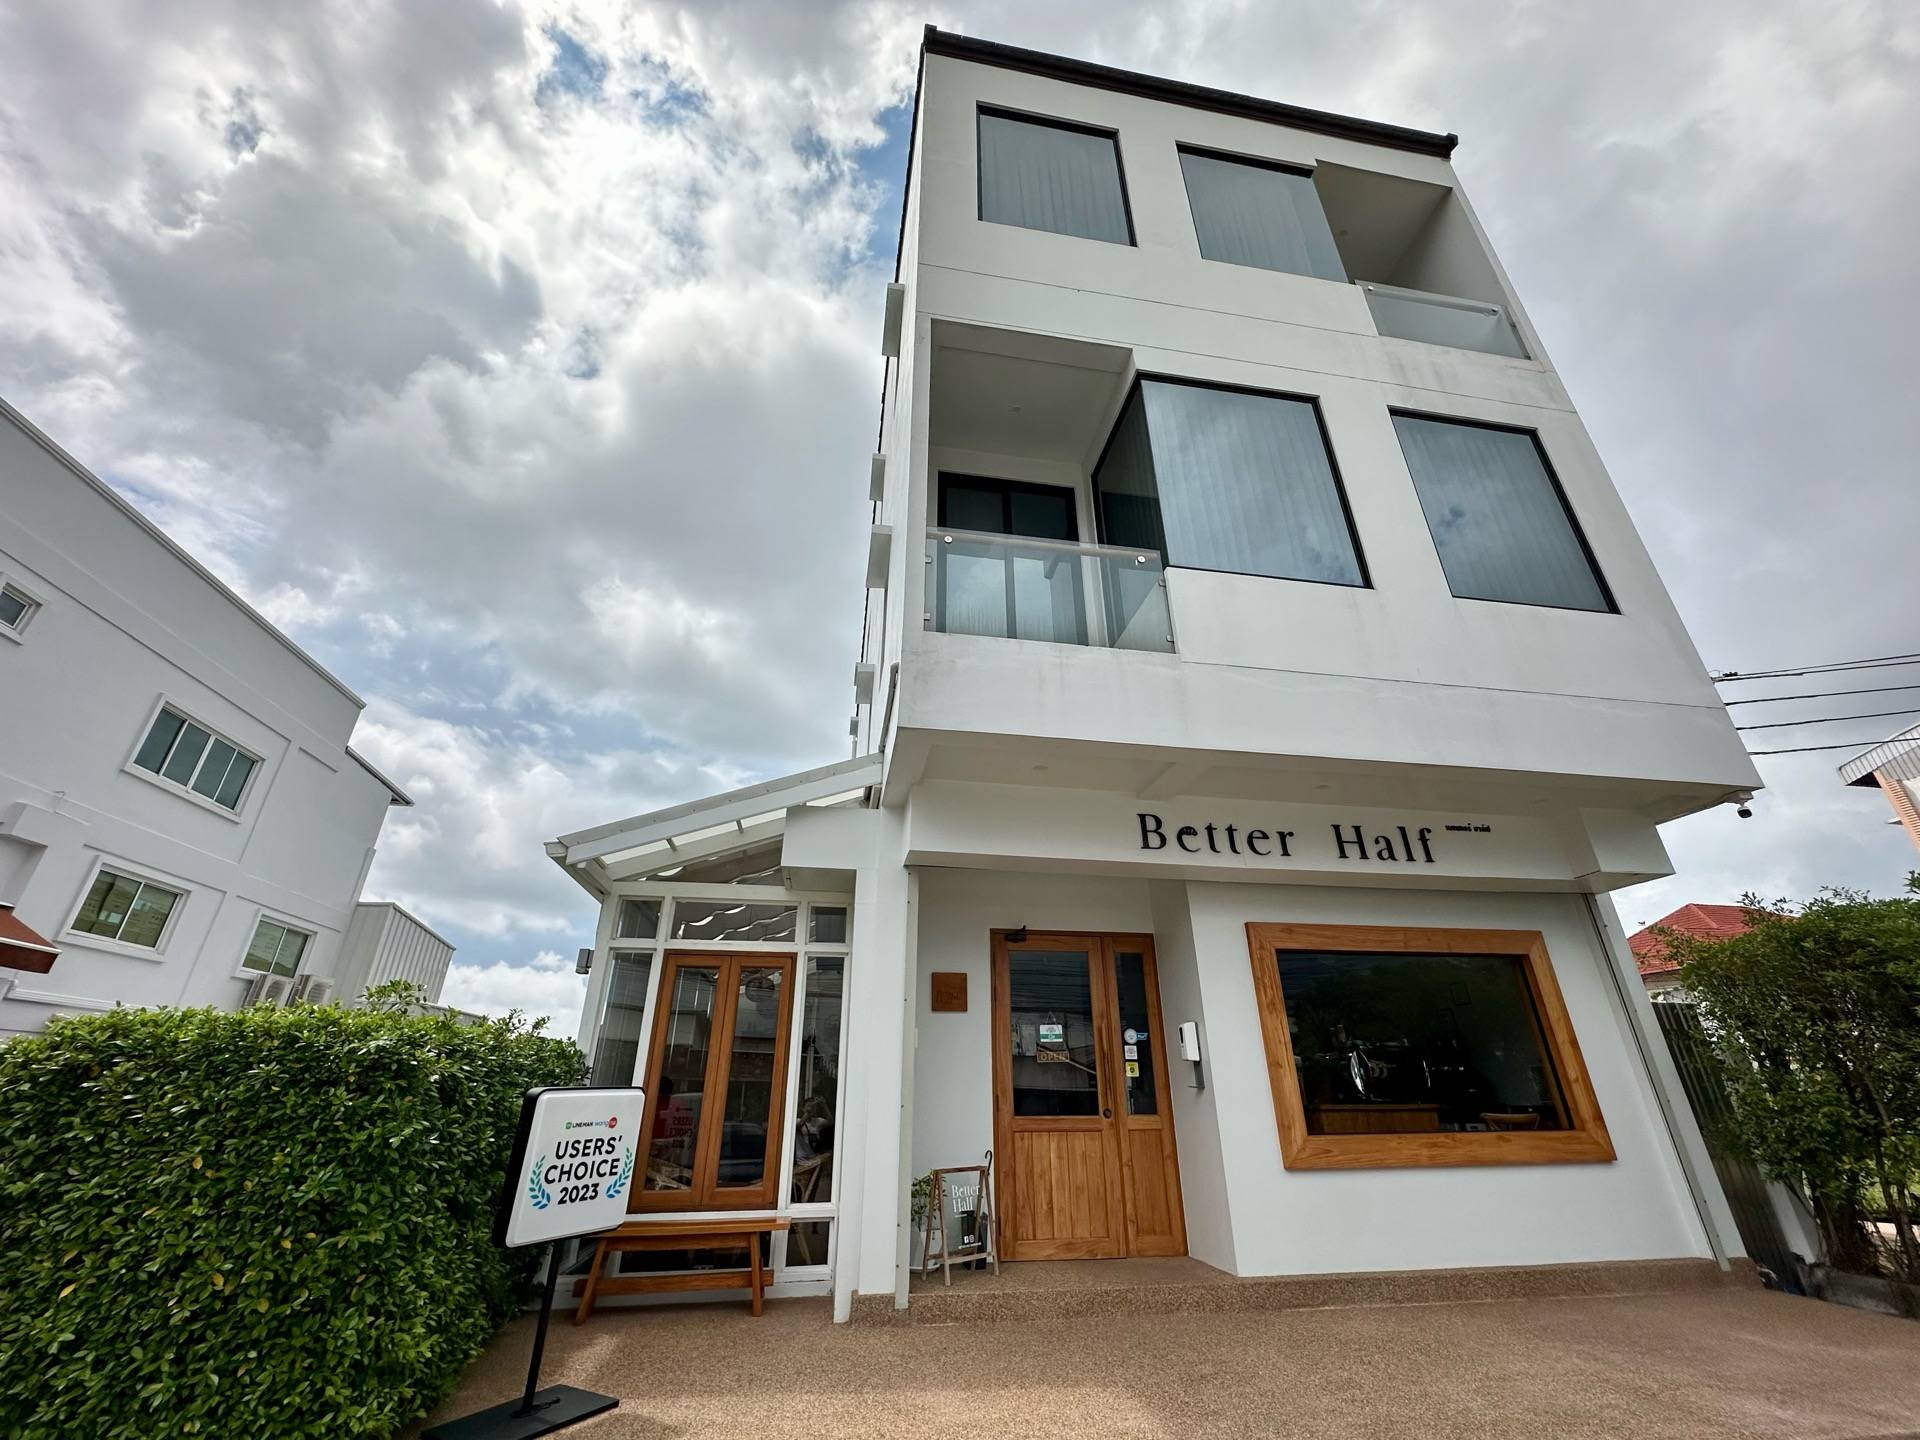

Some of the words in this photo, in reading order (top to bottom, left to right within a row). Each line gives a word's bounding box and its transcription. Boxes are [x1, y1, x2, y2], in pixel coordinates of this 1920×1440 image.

[1136, 813, 1295, 857] Better
[1330, 824, 1437, 863] Half
[555, 1135, 623, 1160] USERS'
[544, 1158, 620, 1184] CHOICE
[557, 1183, 600, 1205] 2023
[952, 1184, 980, 1198] Better
[953, 1197, 973, 1212] Half
